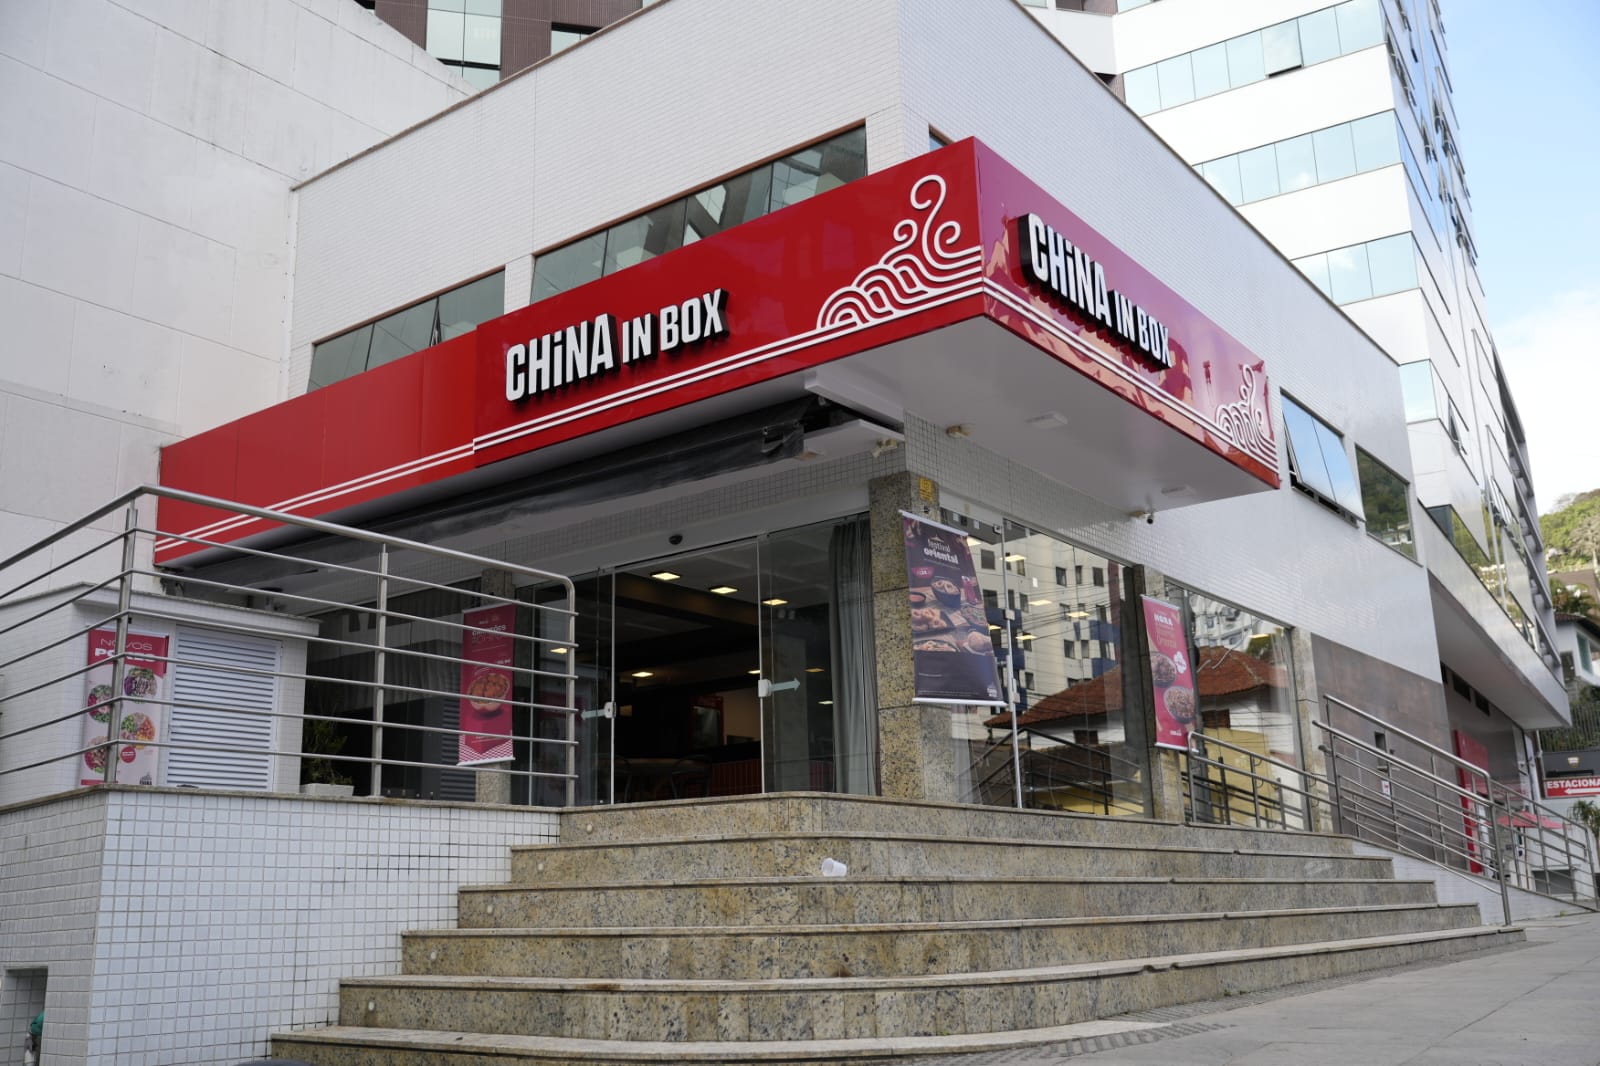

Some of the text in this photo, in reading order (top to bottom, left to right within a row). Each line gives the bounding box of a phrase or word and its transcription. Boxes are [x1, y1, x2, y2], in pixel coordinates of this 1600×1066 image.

[622, 313, 652, 363] IN
[660, 288, 724, 351] BOX
[1114, 289, 1136, 343] IN
[1137, 305, 1173, 368] BOX
[924, 547, 959, 565] oriental
